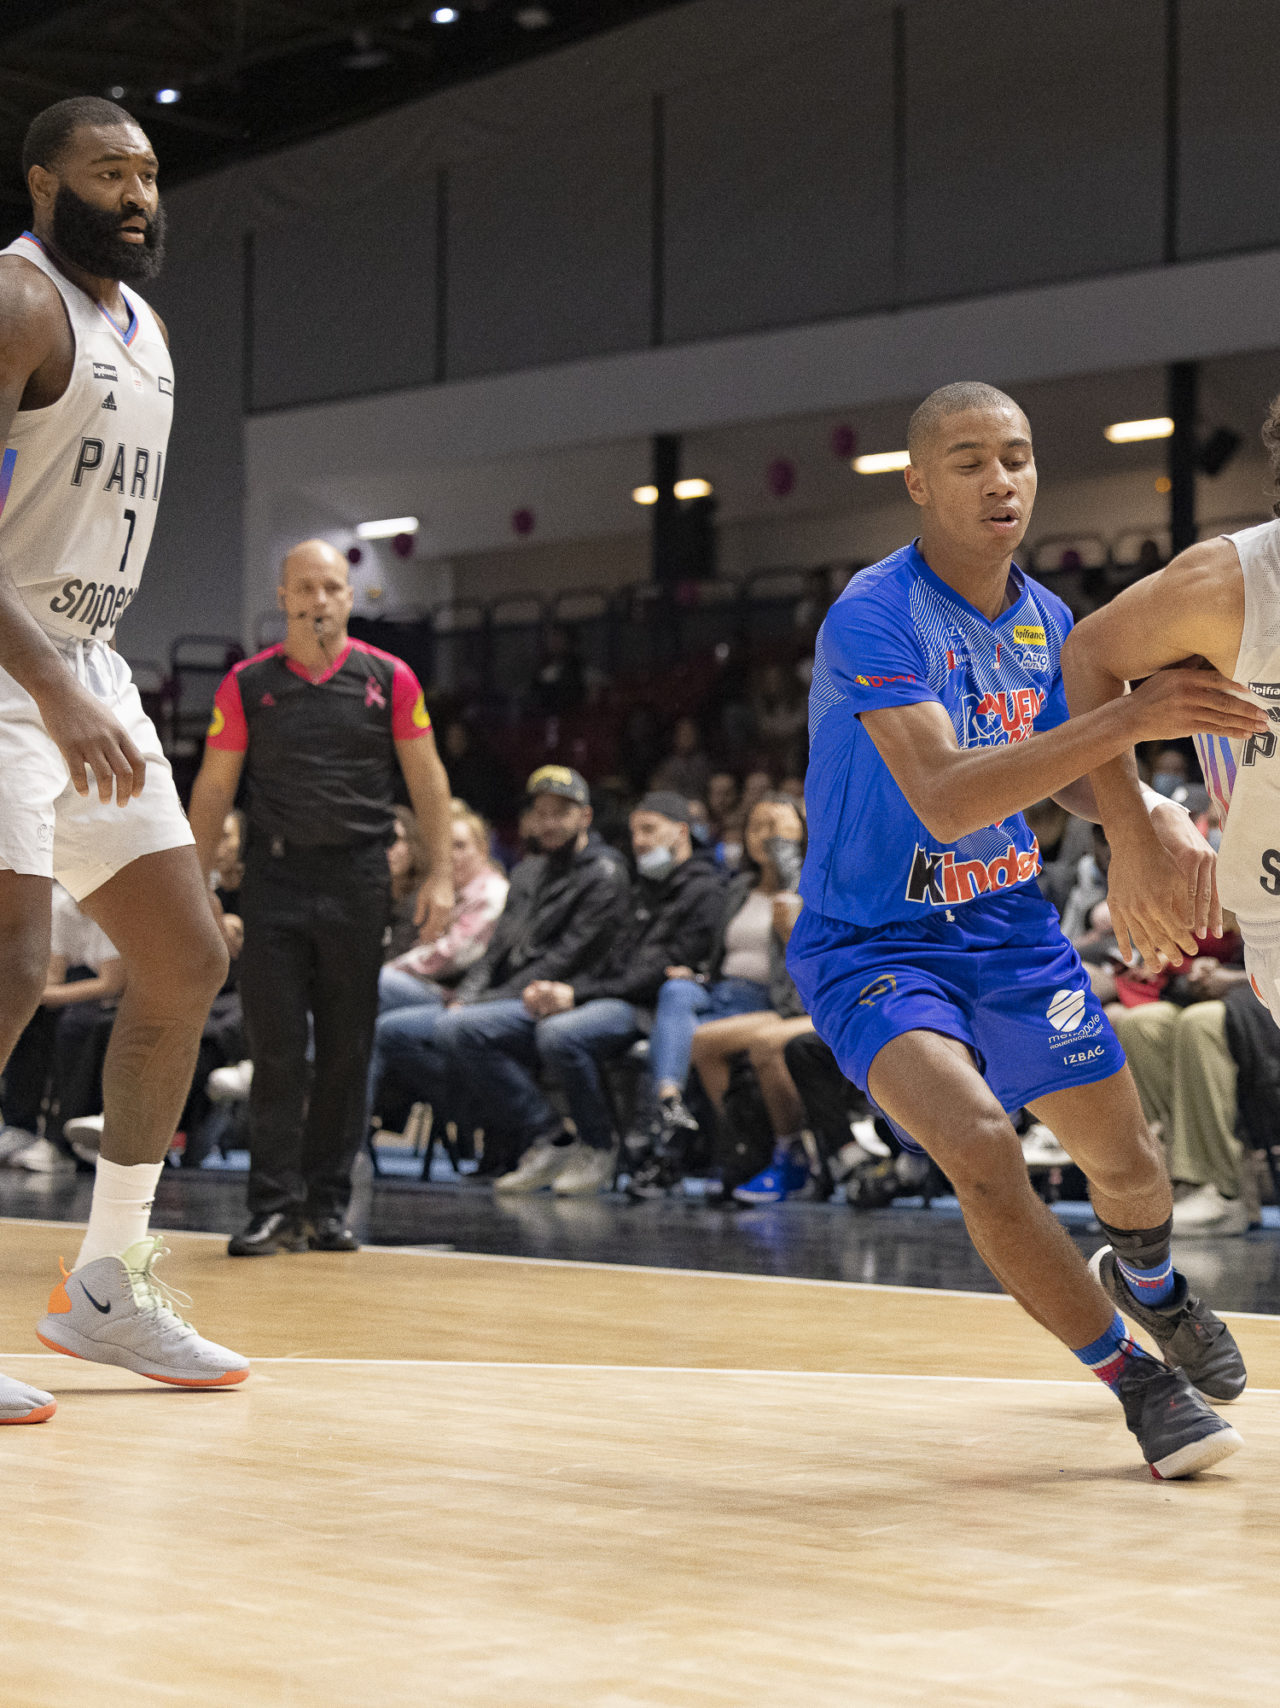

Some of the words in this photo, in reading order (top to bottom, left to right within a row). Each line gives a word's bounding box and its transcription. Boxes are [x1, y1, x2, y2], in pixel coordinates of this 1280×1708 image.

[118, 508, 137, 573] 7
[1014, 628, 1045, 642] bpifrance
[1063, 1045, 1105, 1065] IZBAC
